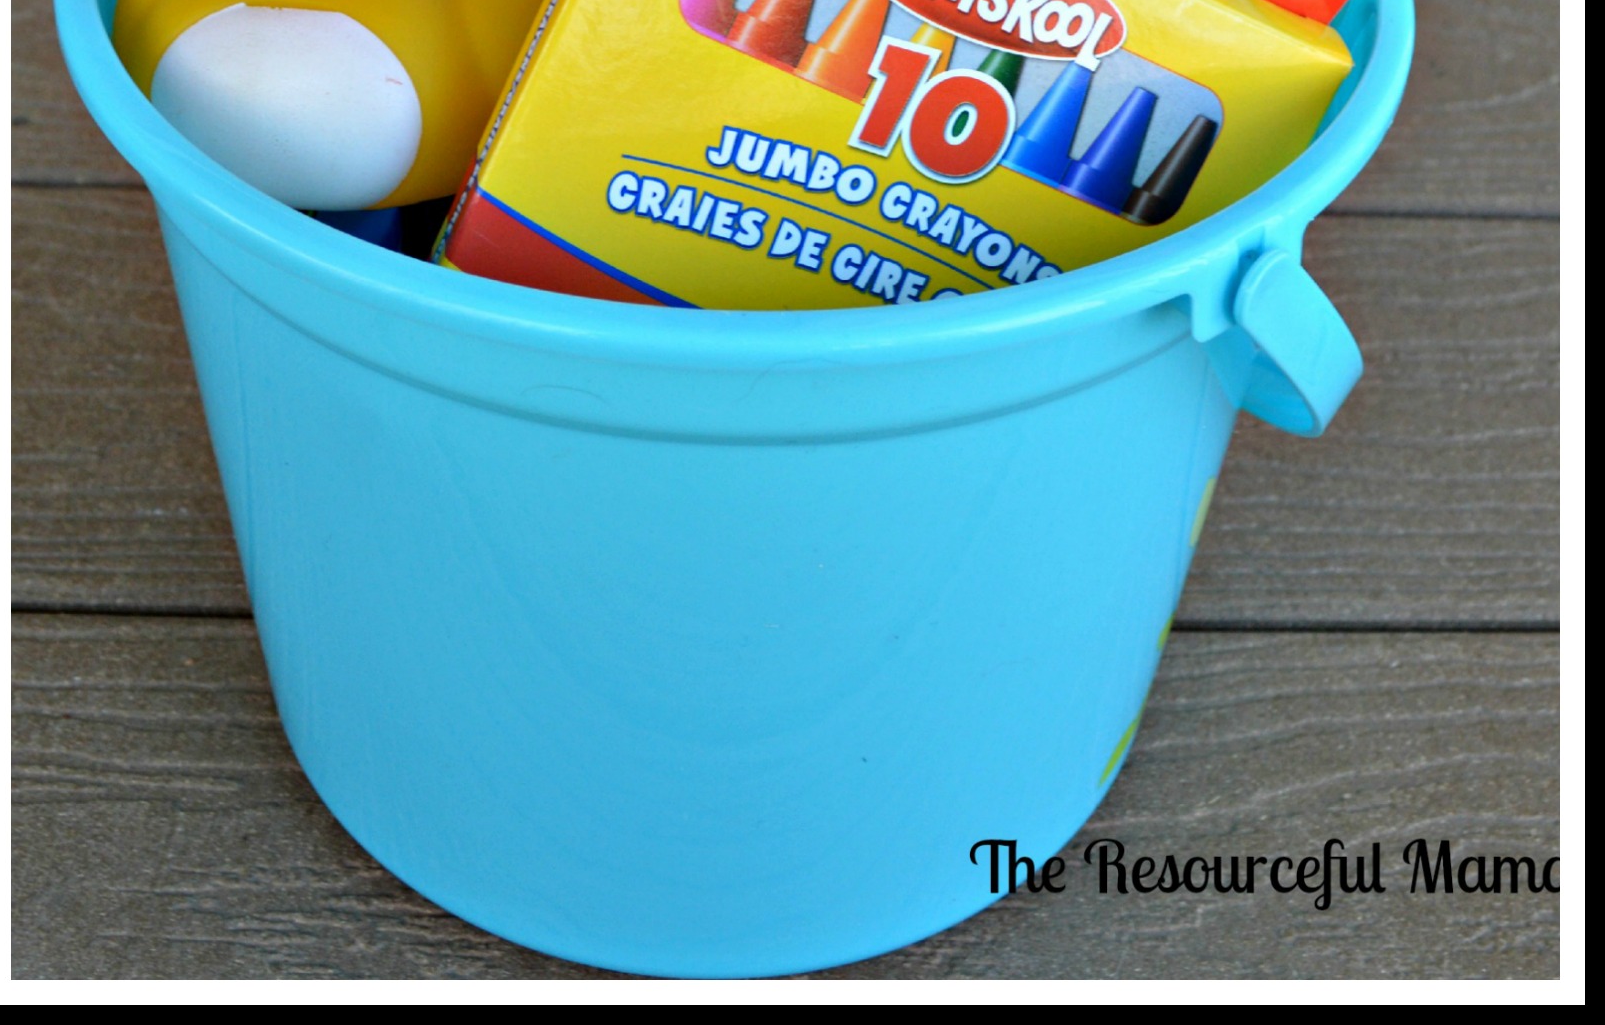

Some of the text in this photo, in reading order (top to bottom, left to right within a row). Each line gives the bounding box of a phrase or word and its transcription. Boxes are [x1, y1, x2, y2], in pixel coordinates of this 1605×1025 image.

[706, 125, 877, 205] JUMBO
[848, 37, 1017, 184] 10
[606, 170, 931, 305] CRAIES DE CIRE
